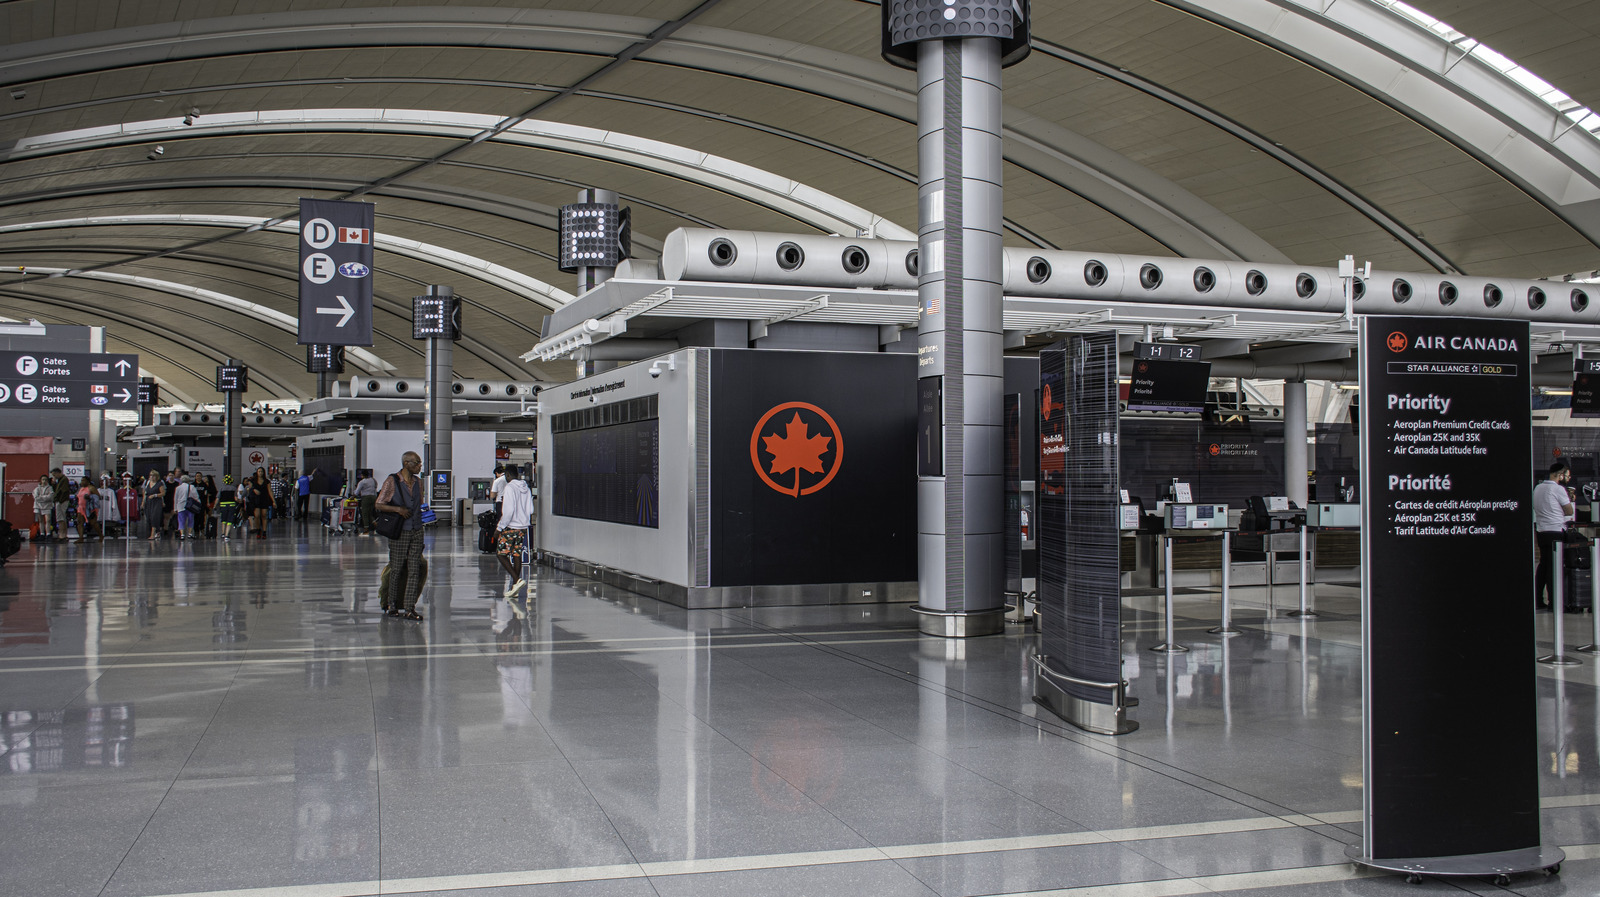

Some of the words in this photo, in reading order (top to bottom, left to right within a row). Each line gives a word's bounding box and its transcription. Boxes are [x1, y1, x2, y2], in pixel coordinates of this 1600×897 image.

[313, 223, 329, 244] D
[572, 210, 604, 260] 2
[312, 258, 328, 278] E
[420, 300, 444, 333] 3
[1414, 336, 1446, 349] AIR
[1450, 336, 1518, 352] CANADA
[313, 344, 332, 368] 4
[1151, 346, 1162, 356] 1-1
[1180, 348, 1193, 358] 1-2
[22, 358, 32, 372] F
[42, 358, 68, 366] Gates
[42, 368, 70, 376] Portes
[222, 368, 237, 388] 5
[22, 386, 32, 400] E
[1387, 393, 1451, 414] Priority
[1394, 420, 1431, 431] Aeroplan
[1432, 420, 1467, 429] Premium
[1468, 420, 1490, 429] Credit
[1491, 421, 1510, 430] Cards
[925, 425, 930, 464] 1
[1394, 433, 1431, 444] Aeroplan
[1432, 433, 1448, 441] 25K
[1450, 433, 1464, 442] and
[1466, 433, 1480, 442] 35K
[1394, 446, 1406, 454] Air
[1408, 445, 1439, 454] Canada
[1440, 445, 1471, 454] Latitude
[1472, 445, 1487, 454] fare
[1388, 474, 1451, 490] Priorité
[1394, 501, 1422, 510] Cartes
[1424, 500, 1433, 509] de
[1435, 500, 1458, 509] crédit
[1459, 500, 1491, 510] Aéroplan
[1492, 500, 1518, 510] prestige
[1394, 514, 1432, 524] Aéroplan
[1434, 514, 1450, 522] 25K
[1461, 513, 1476, 521] 35K
[1394, 526, 1414, 535] Tarif
[1416, 525, 1449, 535] Latitude
[1450, 525, 1467, 534] d'Air
[1468, 525, 1495, 534] Canada
